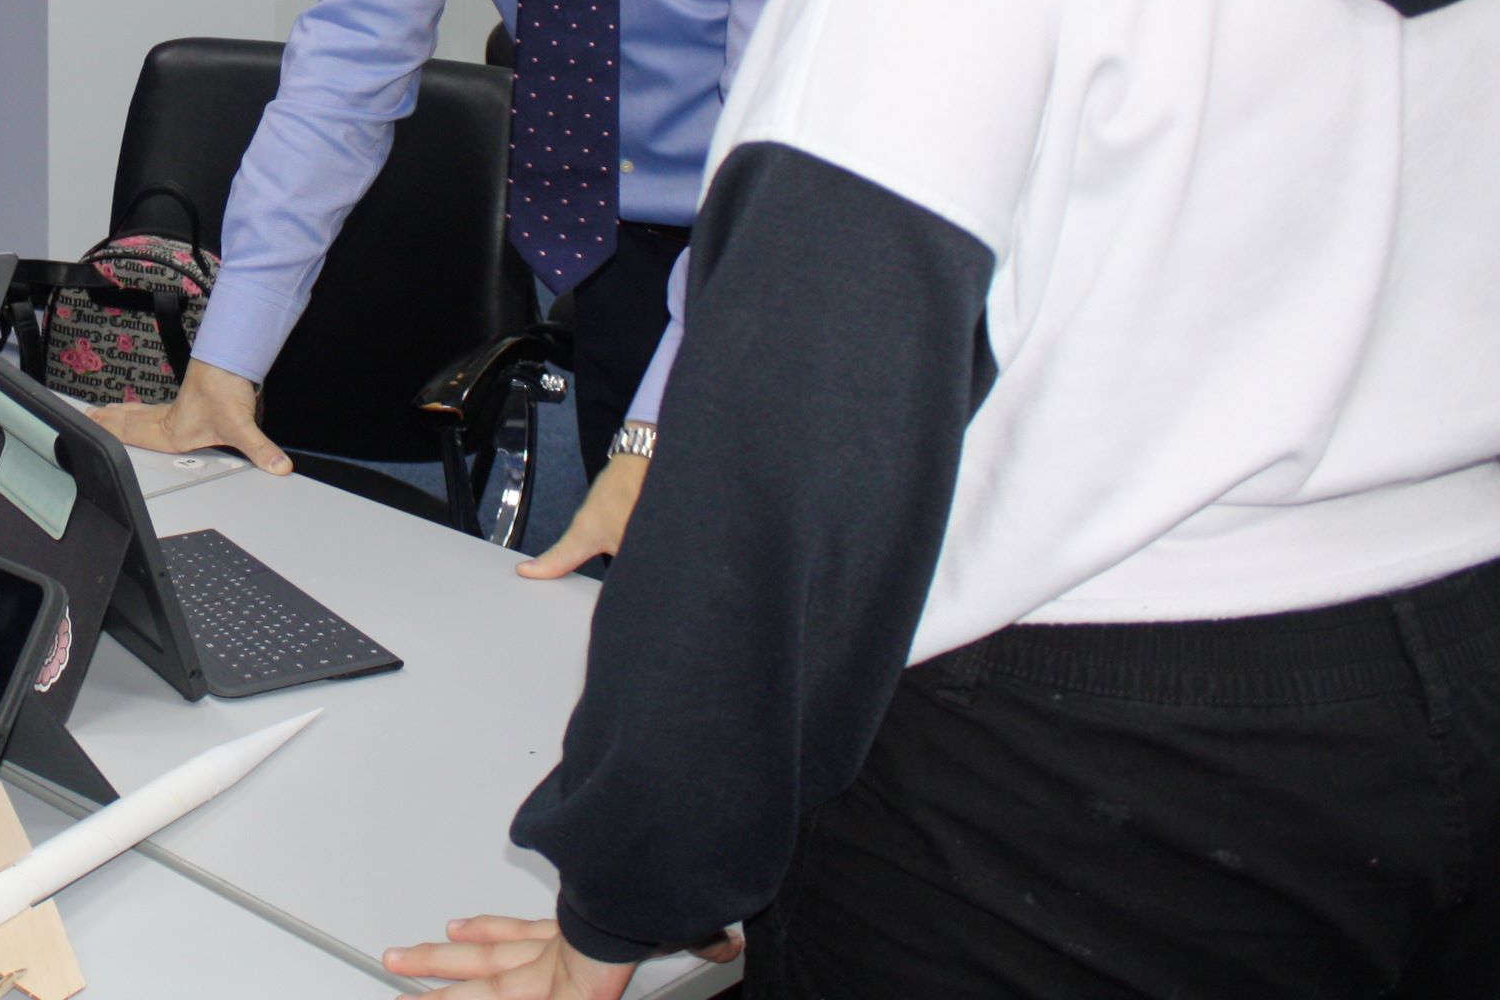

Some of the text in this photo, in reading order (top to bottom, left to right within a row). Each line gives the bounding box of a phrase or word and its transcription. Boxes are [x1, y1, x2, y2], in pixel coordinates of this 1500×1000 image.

[73, 309, 109, 326] Juicy
[106, 346, 160, 367] Couture
[67, 371, 103, 390] Juicy
